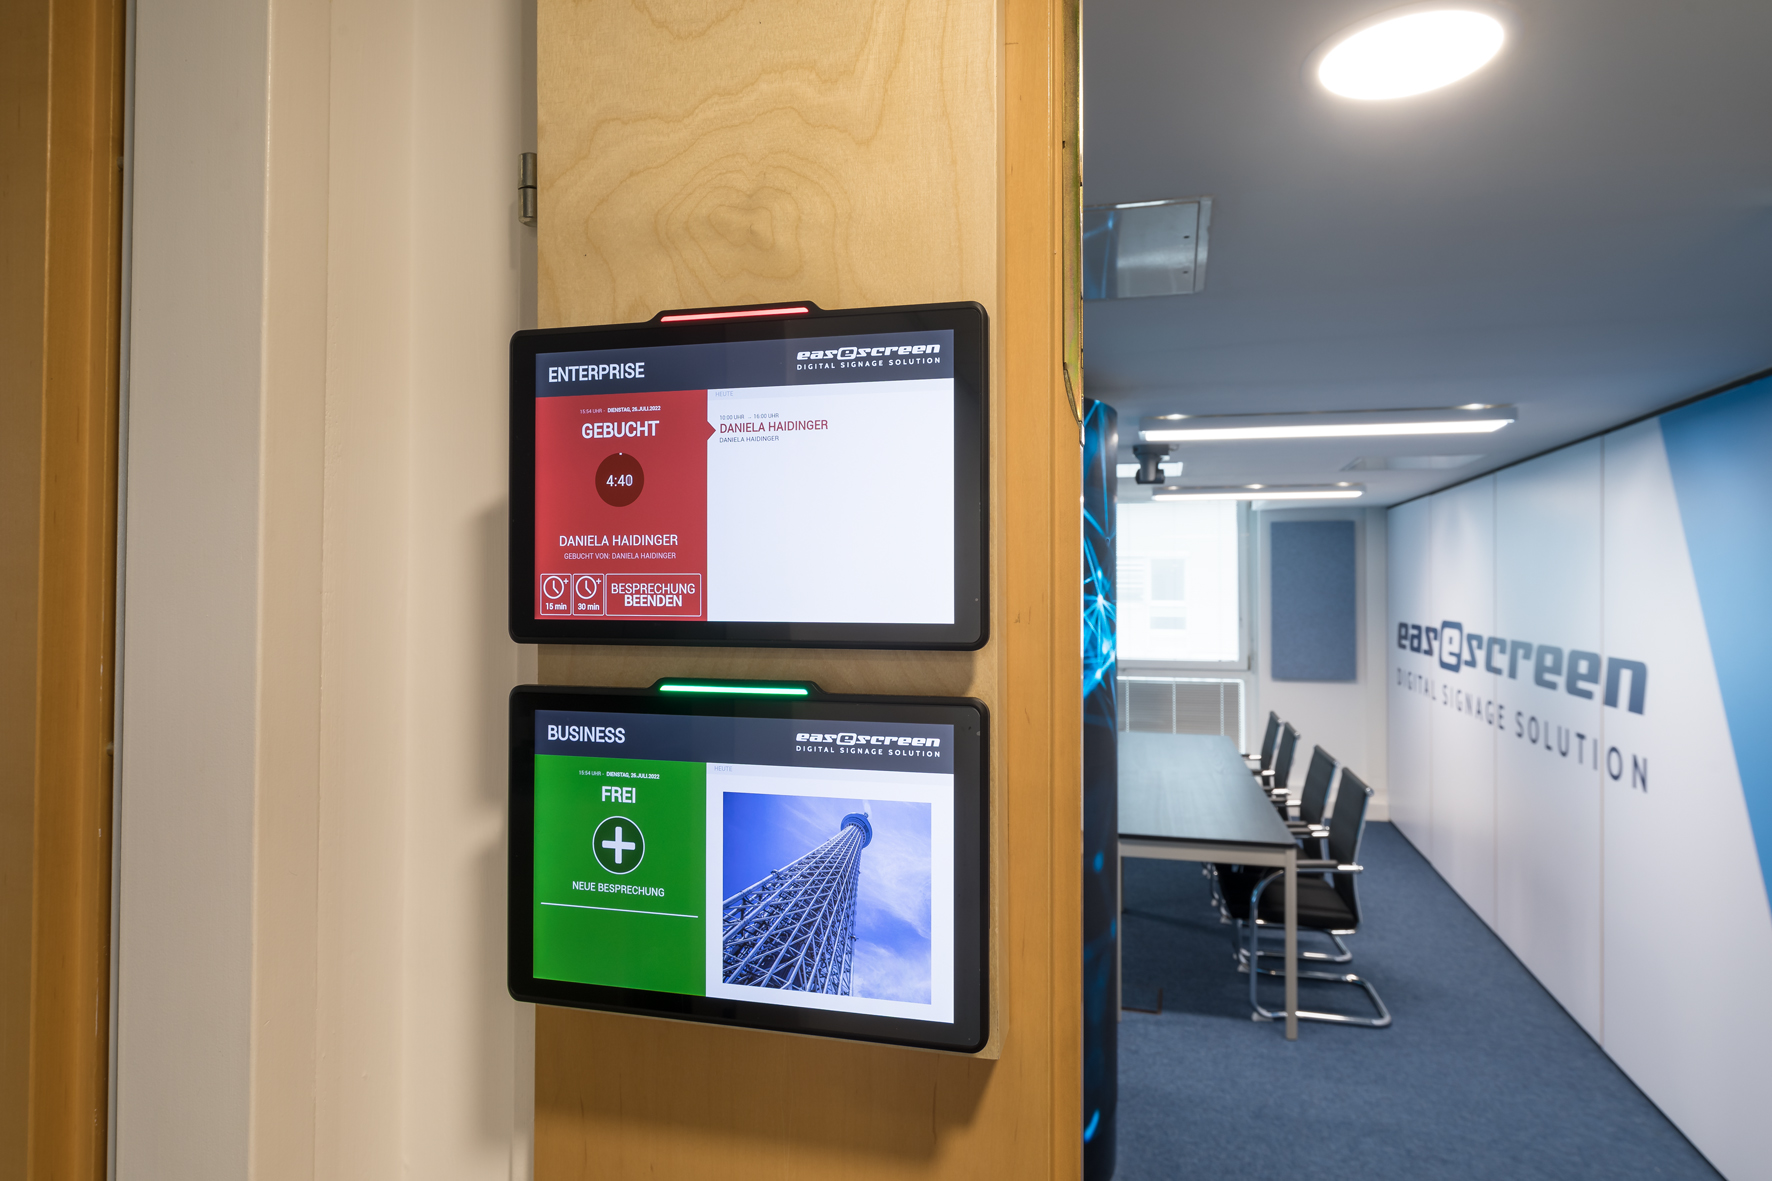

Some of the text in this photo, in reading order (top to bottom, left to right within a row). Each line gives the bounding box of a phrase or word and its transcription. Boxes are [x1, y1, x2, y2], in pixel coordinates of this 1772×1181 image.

[796, 357, 941, 371] DIGITAL SIGNAGE SOLUTION
[548, 362, 645, 383] ENTERPRISE
[581, 420, 660, 439] GEBUCHT
[720, 419, 828, 434] DANIELA HAIDINGER
[606, 473, 633, 487] 4:40
[559, 534, 679, 547] DANIELA HAIDINGER
[563, 551, 677, 560] GEBUCHT VON: DANIELA HAIDINGER
[611, 583, 696, 595] BESPRECHUNG
[577, 603, 600, 611] 30 min
[624, 594, 683, 607] BEENDEN
[547, 724, 626, 744] BUSINESS
[1396, 667, 1648, 794] DIGITAL SIGNAGE SOLUTION
[795, 745, 941, 758] DIGITAL SIGNAGE SOLUTION
[601, 786, 636, 804] FREI
[572, 880, 665, 897] NEUE BESPRECHUNG
